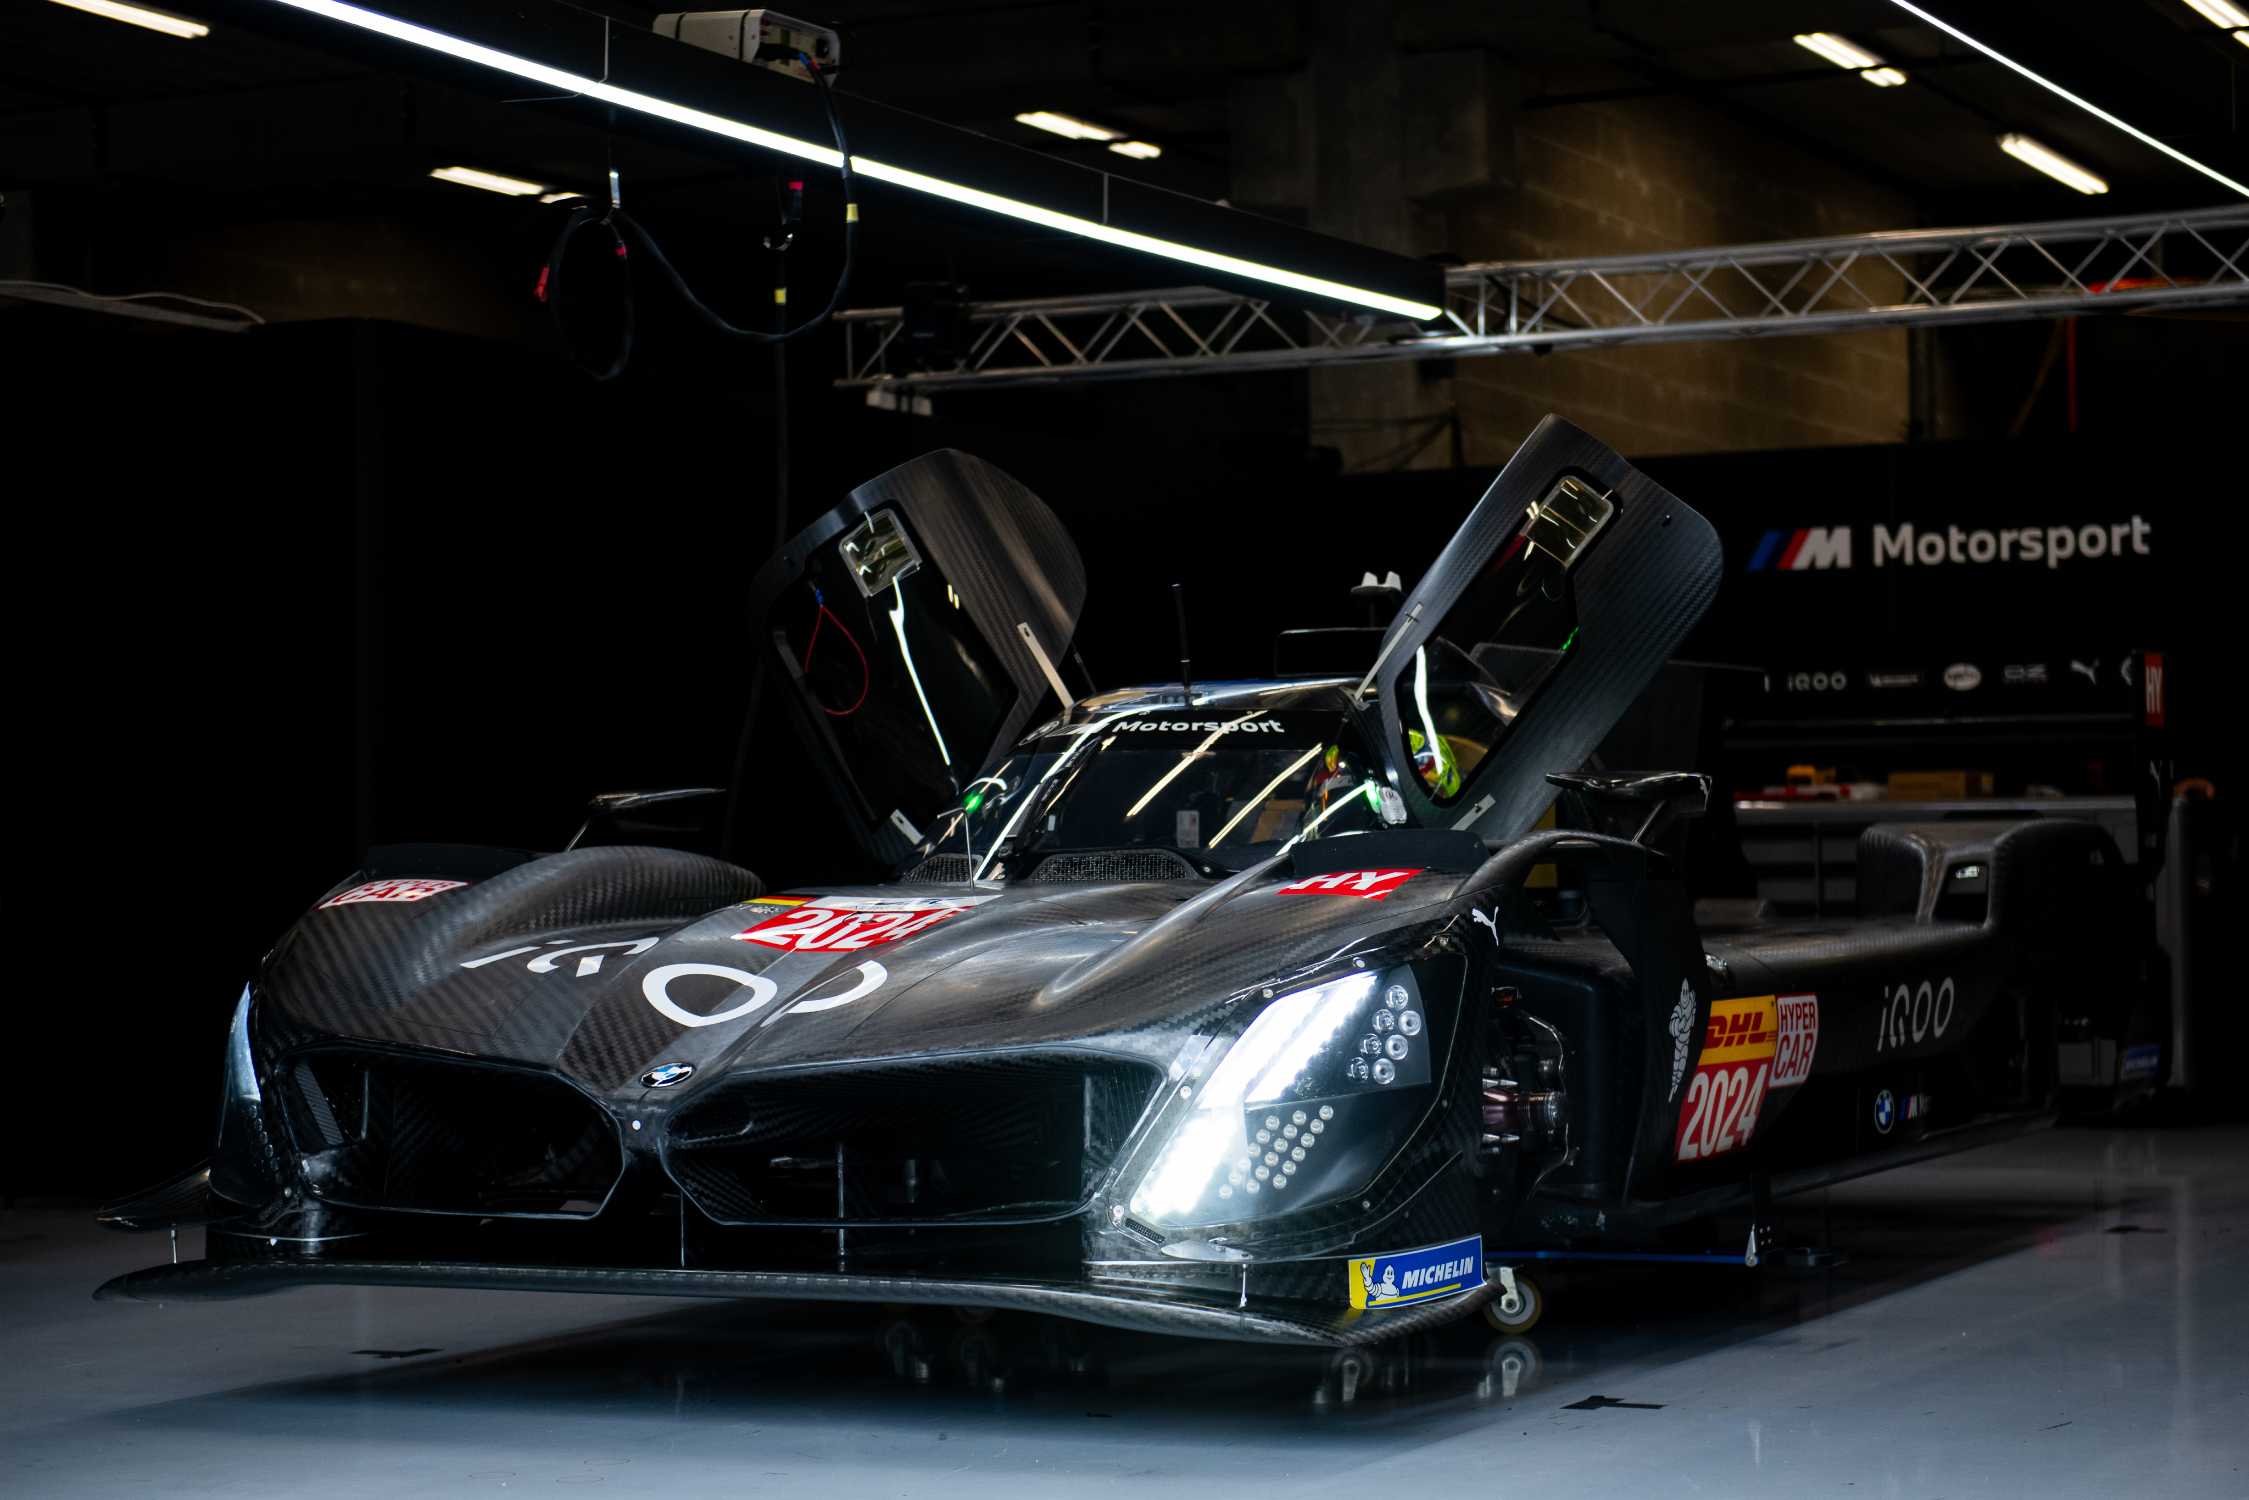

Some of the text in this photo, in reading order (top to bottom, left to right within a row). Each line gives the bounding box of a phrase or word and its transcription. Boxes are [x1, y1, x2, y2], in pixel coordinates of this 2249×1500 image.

[1872, 514, 2152, 570] Motorsport
[1112, 720, 1285, 734] Motorsport
[1286, 871, 1409, 891] HY
[730, 907, 966, 949] 2024
[1703, 1011, 1768, 1049] DHL
[1780, 1002, 1816, 1033] HYPER
[1877, 976, 1955, 1053] iQOO
[1775, 1033, 1814, 1079] CAR
[1678, 1062, 1768, 1161] 2024
[1401, 1256, 1474, 1290] MICHELIN
